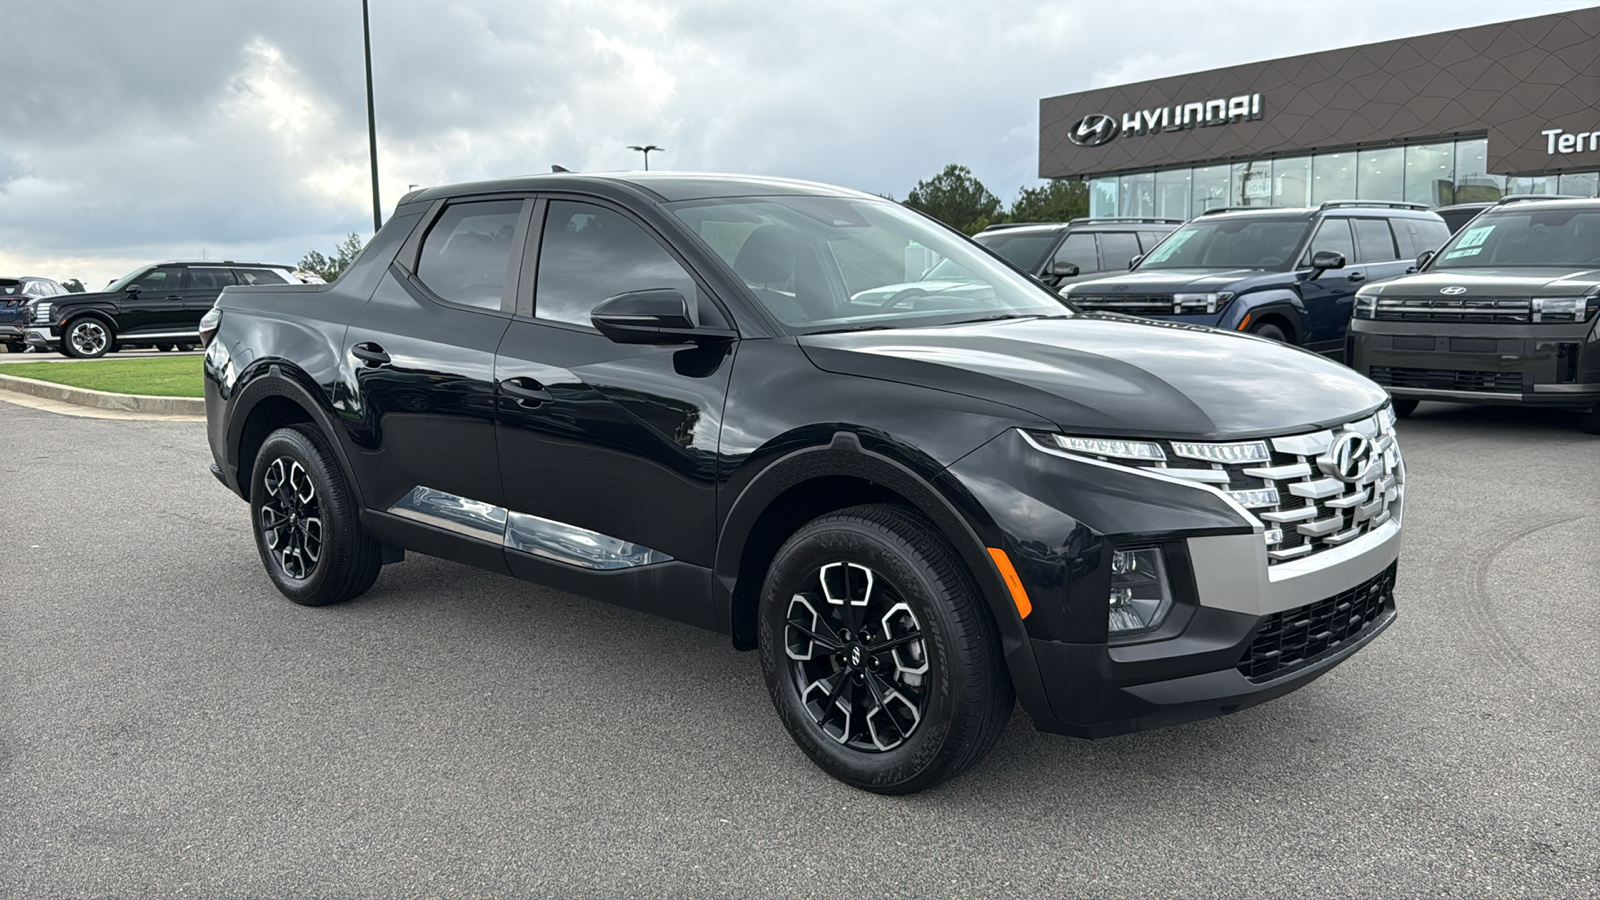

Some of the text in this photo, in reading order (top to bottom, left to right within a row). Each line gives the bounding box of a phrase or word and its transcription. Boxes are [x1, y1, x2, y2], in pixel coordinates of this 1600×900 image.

[1121, 93, 1263, 136] HYUNDAI
[1541, 128, 1600, 155] Terr
[922, 605, 949, 696] CRUGEN
